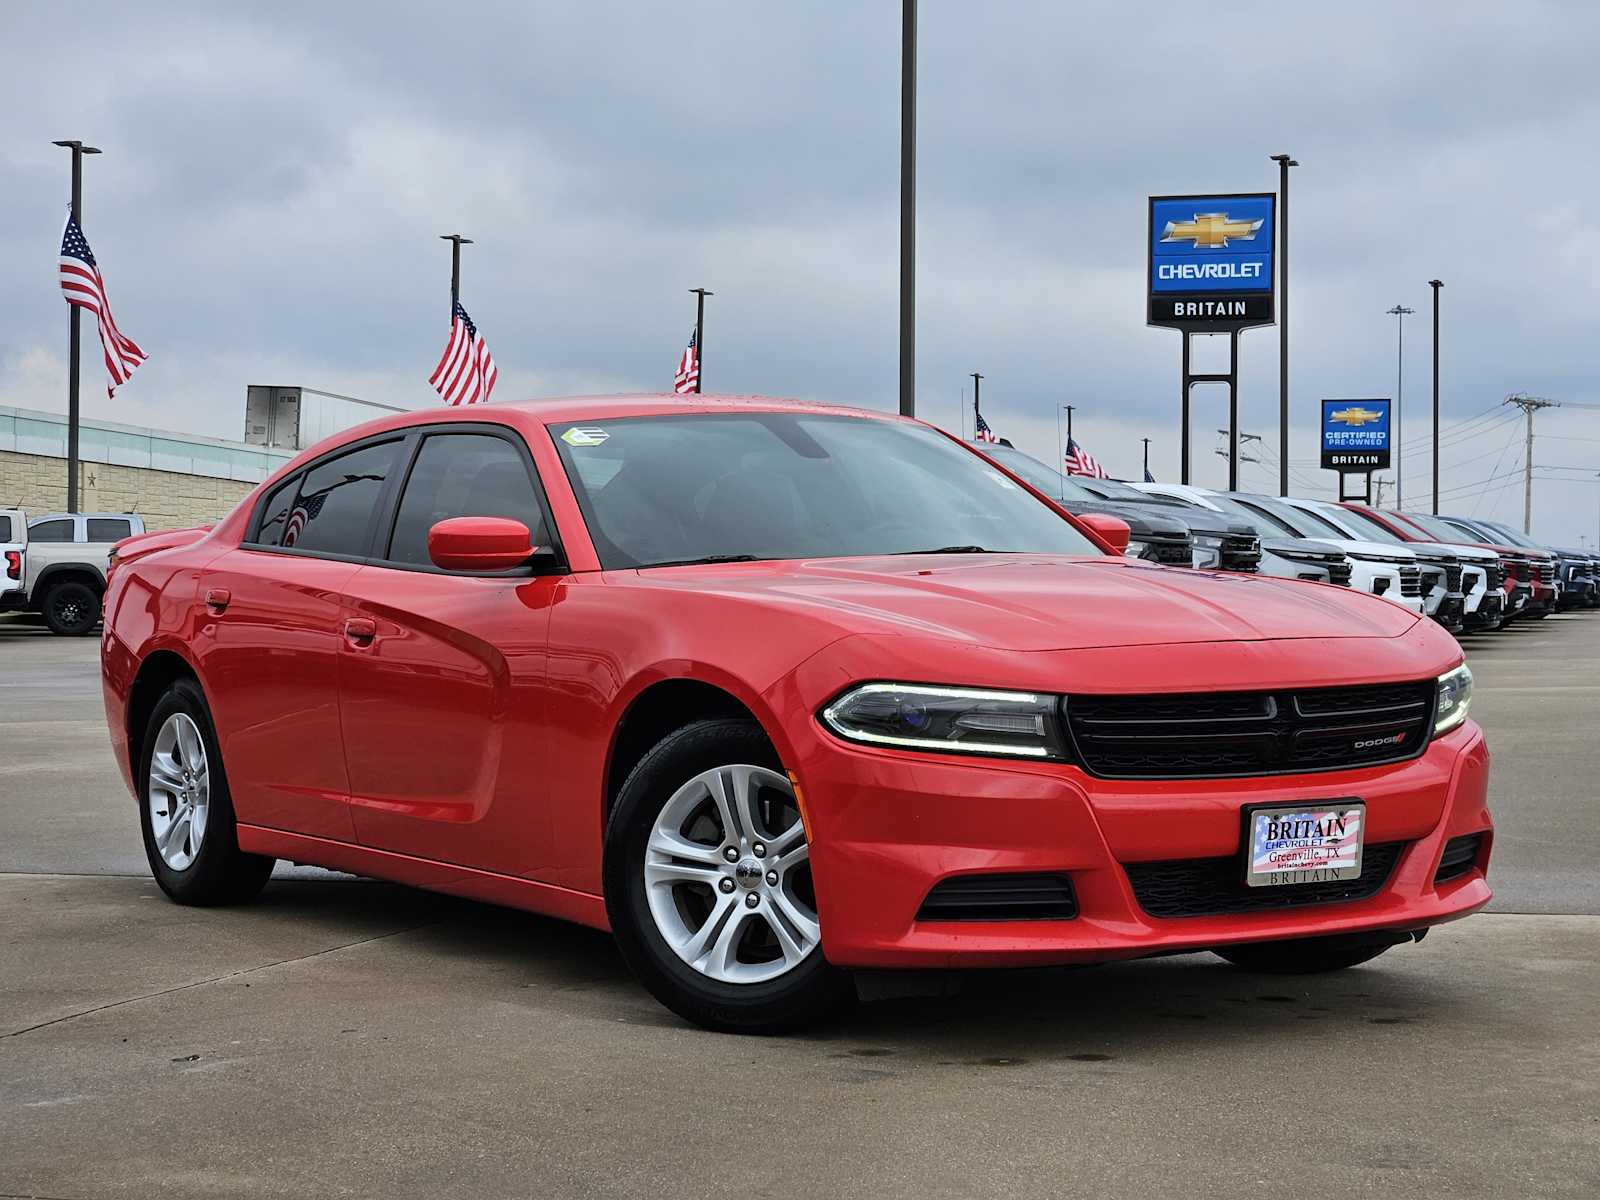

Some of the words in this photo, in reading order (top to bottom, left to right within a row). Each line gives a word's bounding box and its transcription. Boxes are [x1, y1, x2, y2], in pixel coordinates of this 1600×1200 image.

[1158, 262, 1263, 279] CHEVROLET
[1174, 301, 1246, 316] BRITAIN
[1331, 455, 1379, 464] BRITAIN
[1355, 736, 1398, 748] DODGE
[1268, 819, 1346, 840] BRITAIN
[1265, 838, 1323, 850] CHEVROLET
[1269, 848, 1322, 863] Greenville,
[1326, 847, 1340, 859] TX
[1270, 867, 1340, 885] BRITAIN
